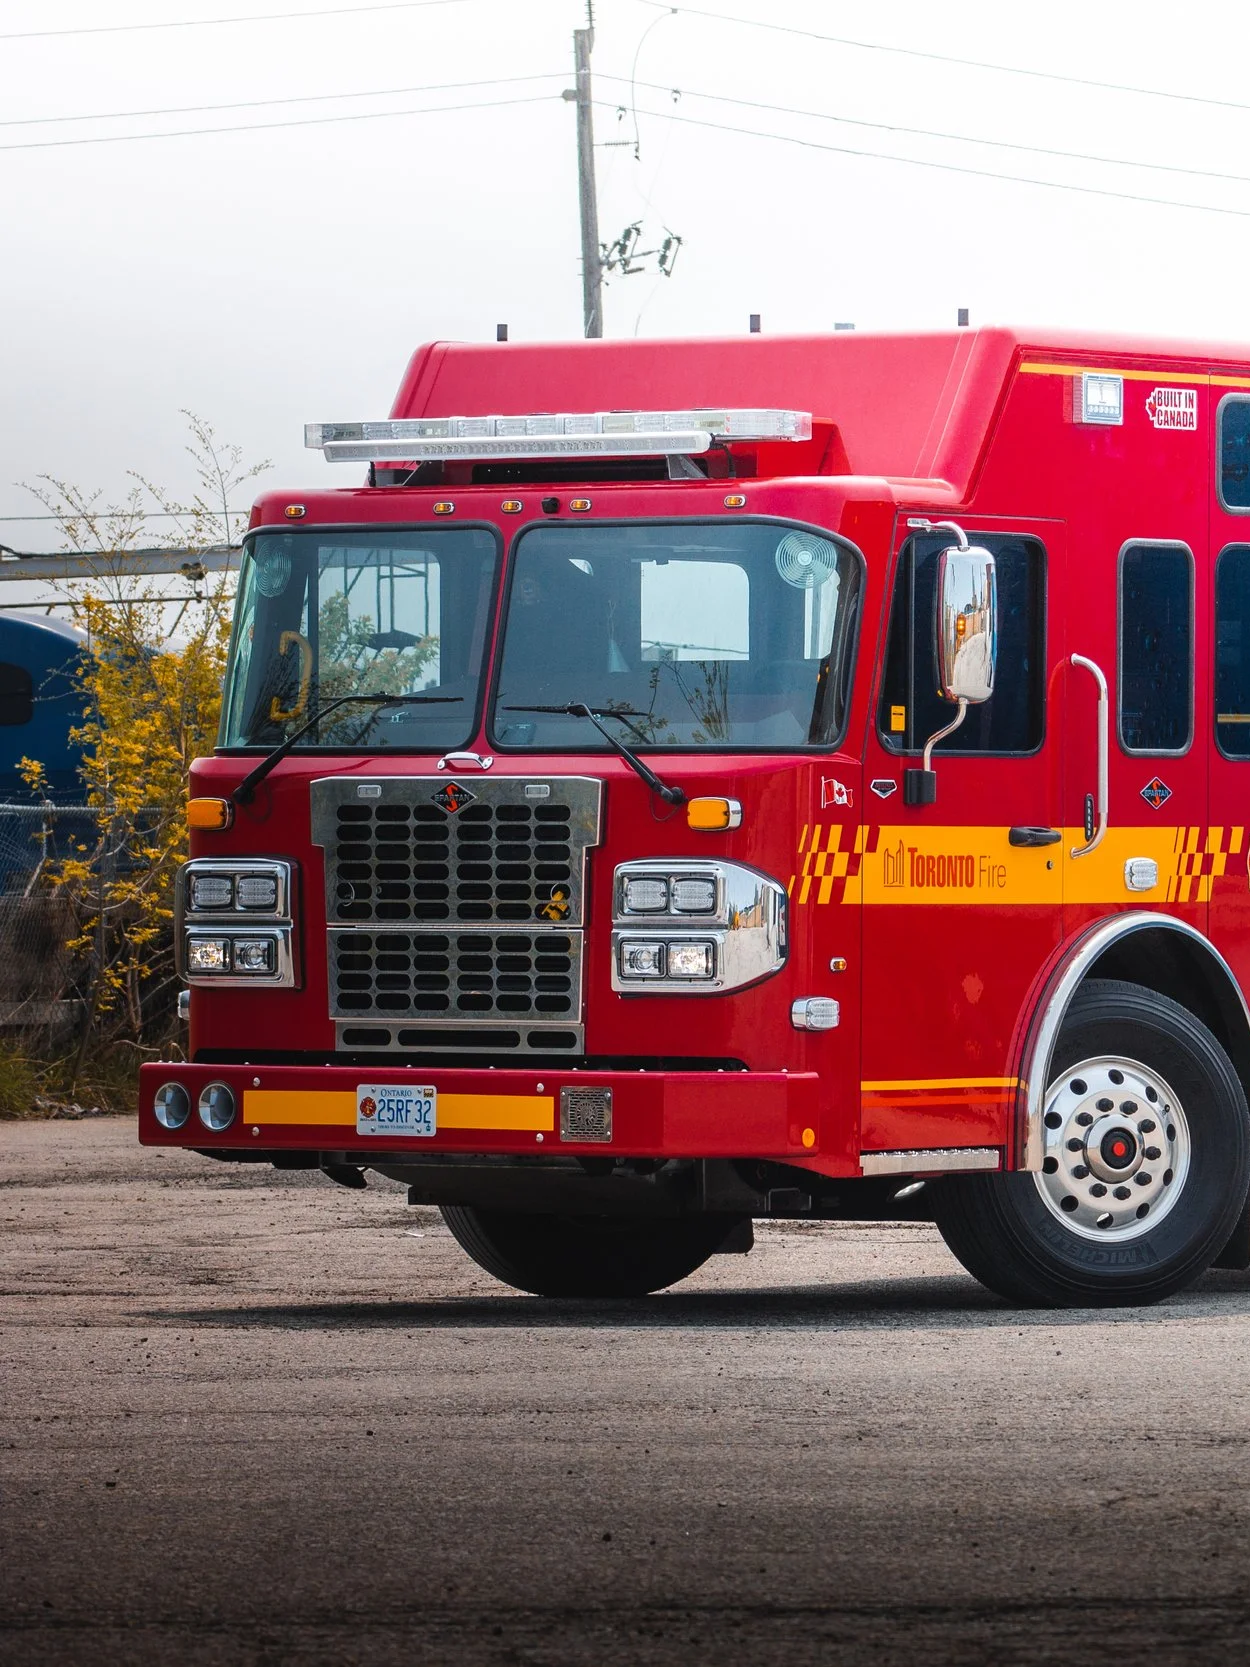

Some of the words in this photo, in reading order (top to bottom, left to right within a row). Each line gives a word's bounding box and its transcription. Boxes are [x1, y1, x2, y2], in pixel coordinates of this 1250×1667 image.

[1157, 390, 1182, 408] BUILT
[1184, 391, 1194, 409] IN
[1157, 409, 1194, 428] CANADA
[907, 847, 975, 888] TORONTO
[978, 855, 1007, 888] Fire
[380, 1088, 412, 1097] ONTARIO
[377, 1099, 432, 1123] 25RF32
